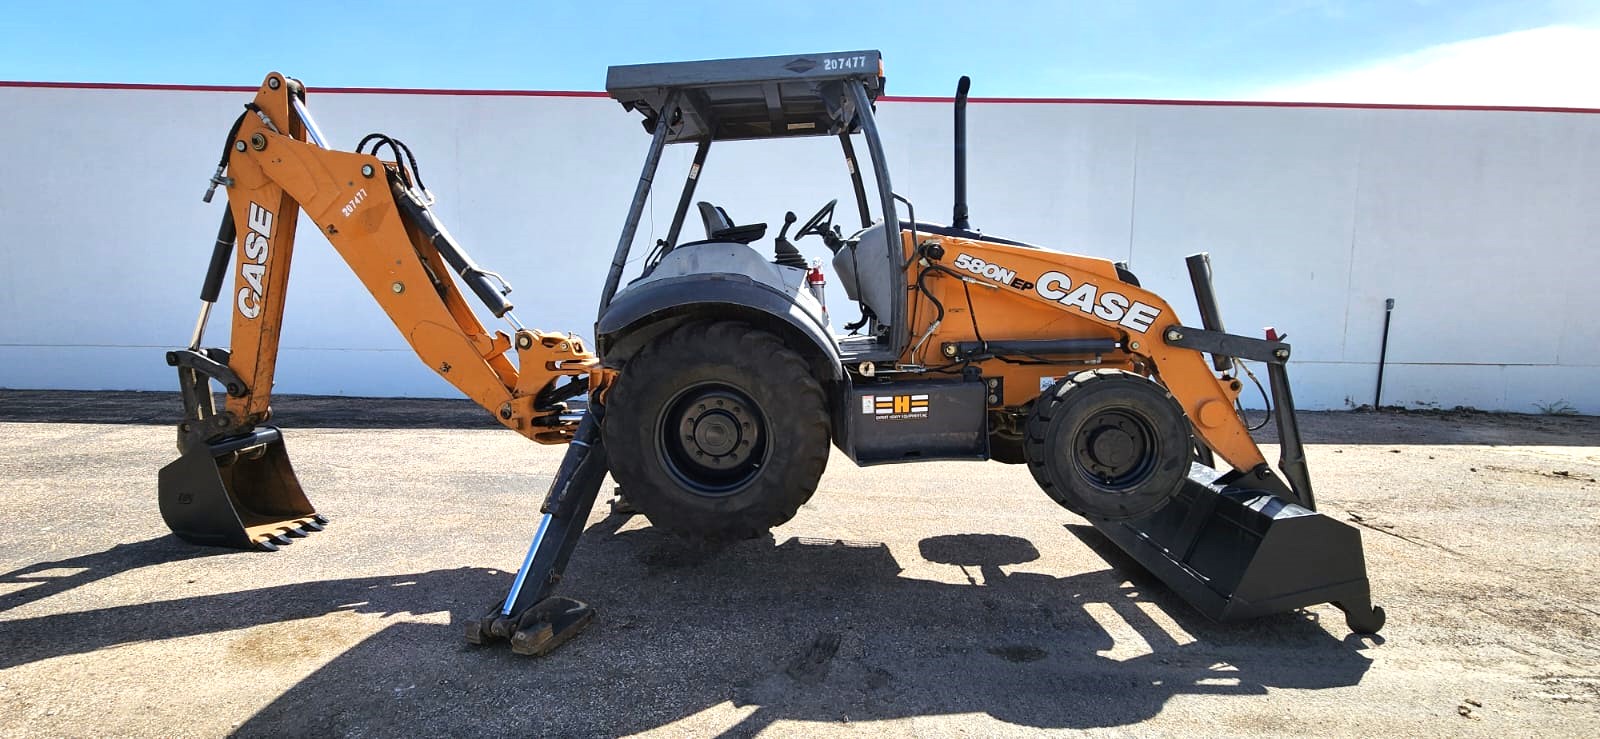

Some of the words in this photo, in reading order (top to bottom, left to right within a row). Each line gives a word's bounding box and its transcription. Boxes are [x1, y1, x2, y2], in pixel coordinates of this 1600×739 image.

[823, 55, 866, 71] 207477
[341, 187, 368, 217] 207477
[237, 200, 274, 320] CASE
[954, 253, 1017, 286] 580N
[1010, 277, 1035, 291] EP
[1036, 270, 1162, 334] CASE
